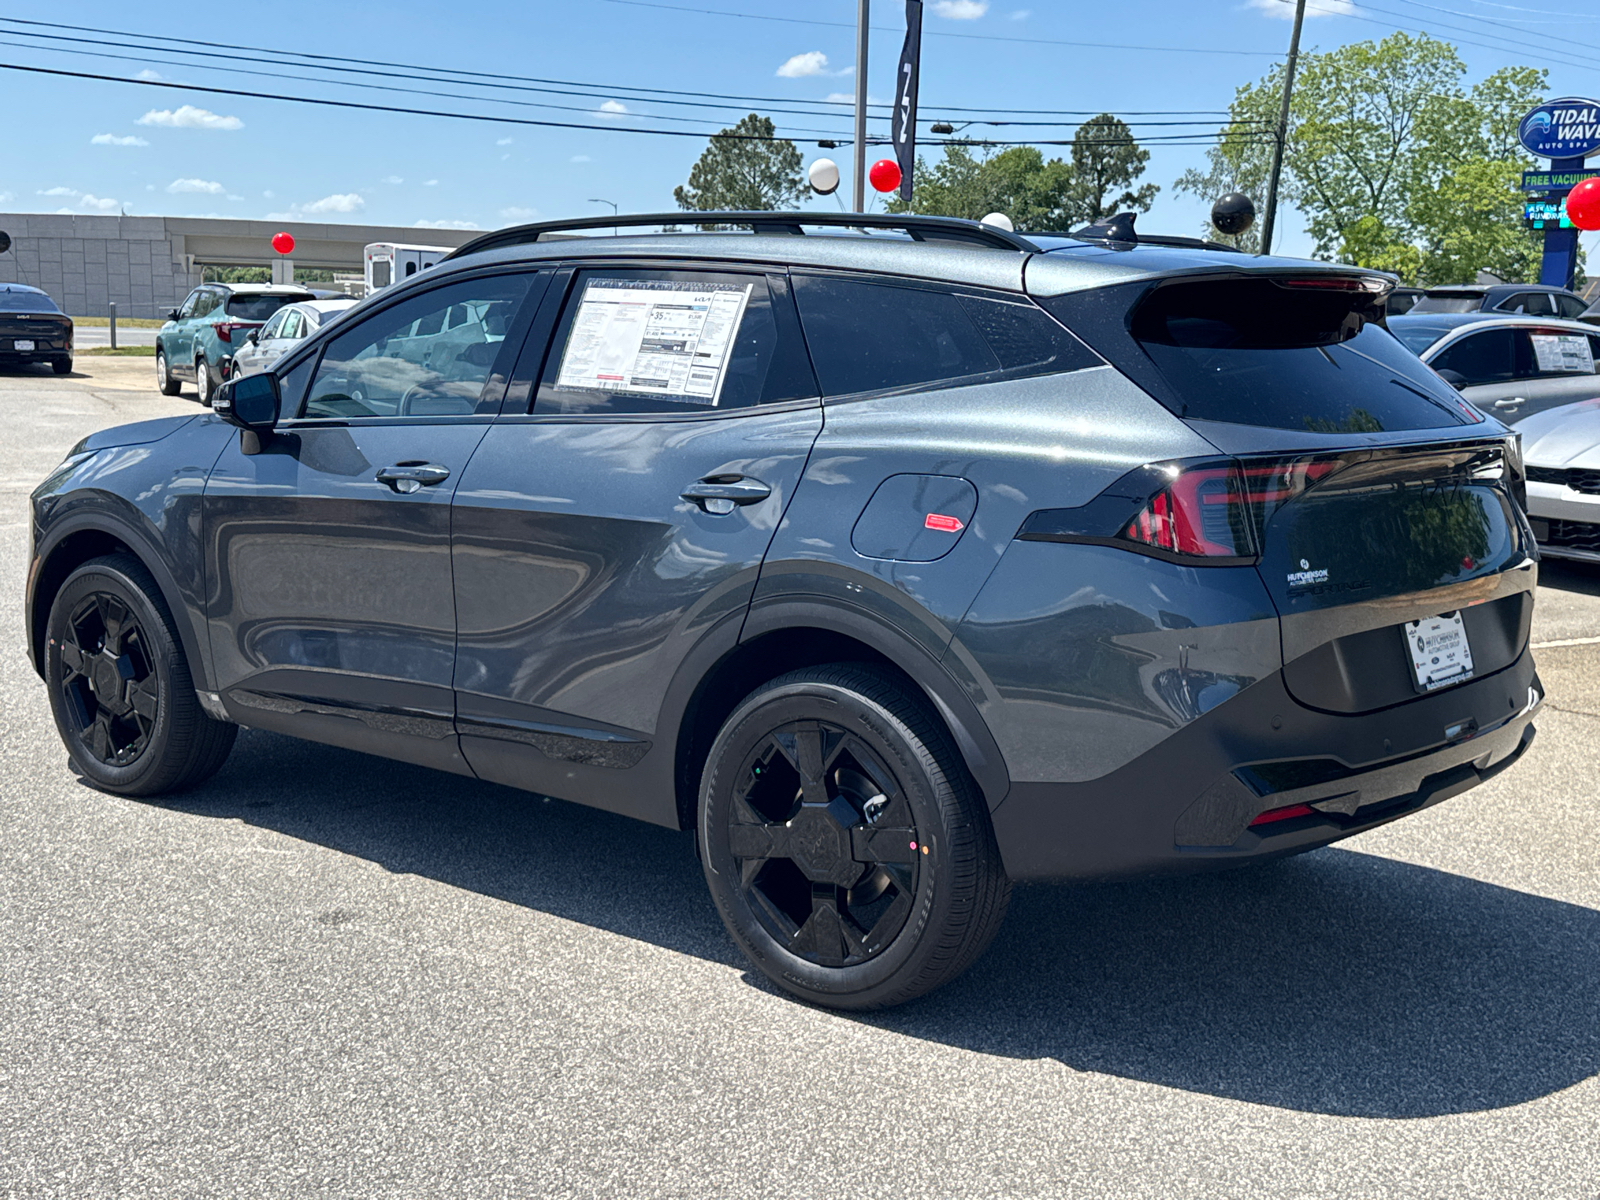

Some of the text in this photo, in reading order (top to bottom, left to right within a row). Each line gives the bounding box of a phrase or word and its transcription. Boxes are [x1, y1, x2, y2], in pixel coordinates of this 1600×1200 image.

[1552, 108, 1597, 125] TIDAL
[1538, 141, 1588, 150] AUTO SPA
[1525, 175, 1550, 186] FREE
[1287, 569, 1329, 582] HUTCHINSON
